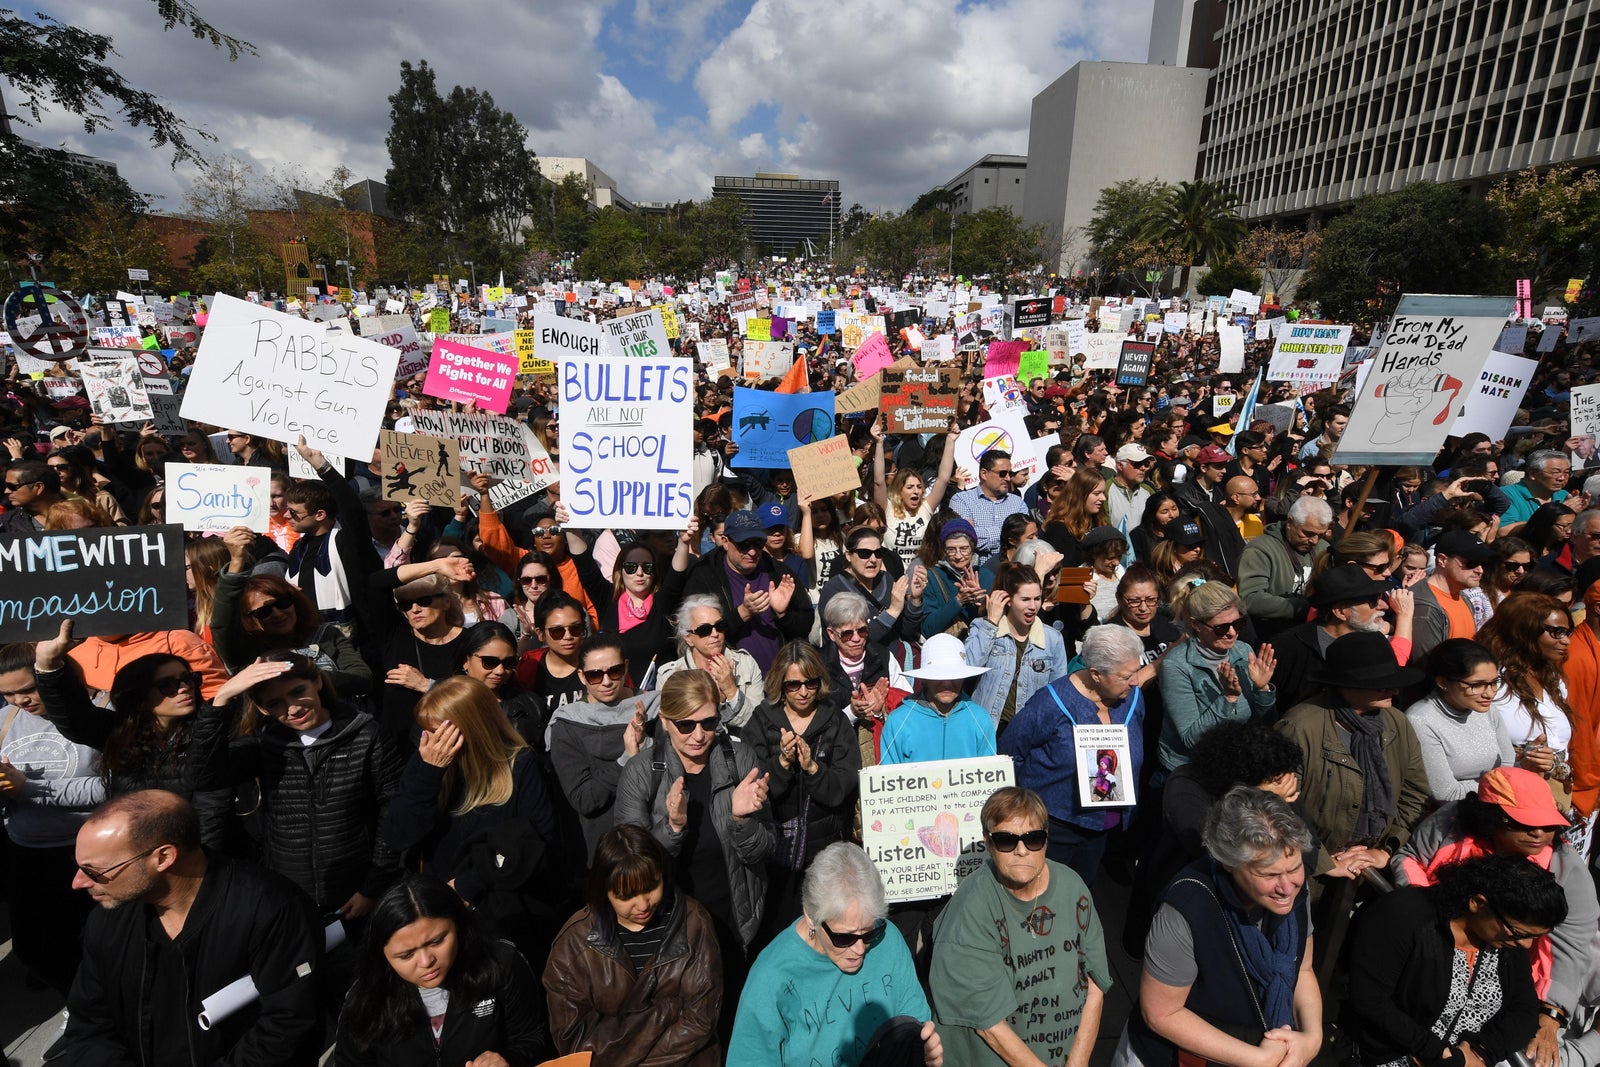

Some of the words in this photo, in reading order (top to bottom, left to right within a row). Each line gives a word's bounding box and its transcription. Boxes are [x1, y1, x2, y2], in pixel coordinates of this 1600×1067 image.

[607, 322, 624, 336] THE
[624, 313, 654, 333] SAFETY
[1291, 327, 1314, 337] HOW
[1314, 329, 1341, 338] MANY
[1436, 318, 1464, 340] My
[541, 328, 599, 356] ENOUGH
[619, 335, 631, 347] OF
[633, 331, 649, 342] OUR
[1386, 333, 1419, 346] Cold
[251, 319, 379, 388] RABBIS
[623, 339, 658, 357] LIVES
[1279, 343, 1306, 353] MORE
[1306, 344, 1330, 353] NEED
[1330, 345, 1343, 354] TO
[439, 348, 496, 372] Together
[497, 362, 513, 376] We
[522, 360, 550, 368] GUNS!
[1125, 353, 1148, 362] NEVER
[1381, 352, 1442, 373] Hands
[438, 364, 473, 381] Fight
[475, 372, 492, 386] for
[492, 378, 507, 390] All
[883, 368, 904, 383] how
[940, 372, 950, 383] is
[1122, 364, 1146, 373] AGAIN
[565, 361, 689, 403] BULLETS
[1481, 371, 1522, 388] DISARM
[222, 360, 308, 402] Against
[315, 390, 357, 420] Gun
[881, 385, 900, 393] our
[1480, 385, 1509, 399] HATE
[1217, 398, 1231, 406] LESS
[1573, 393, 1596, 406] THE
[250, 398, 340, 443] Violence
[587, 407, 613, 422] ARE
[619, 407, 648, 422] NOT
[894, 406, 956, 421] gender-inclusive
[413, 415, 444, 433] HOW
[449, 416, 487, 435] MANY
[489, 419, 522, 441] TEARS
[388, 432, 414, 446] I'LL
[492, 437, 526, 456] BLOOD
[386, 444, 437, 464] NEVER
[568, 431, 680, 474] SCHOOL
[468, 460, 484, 474] IT
[487, 458, 526, 478] TAKE?
[419, 475, 447, 500] GROW
[529, 479, 548, 494] CLASS
[177, 472, 252, 520] Sanity
[438, 488, 456, 506] UP
[570, 477, 692, 518] SUPPLIES
[26, 535, 78, 573] ME
[78, 533, 166, 567] WITH
[869, 775, 928, 794] Listen
[948, 768, 1006, 787] Listen
[896, 794, 937, 804] CHILDREN
[943, 791, 958, 799] with
[871, 808, 886, 816] PAY
[889, 804, 937, 815] ATTENTION
[866, 846, 926, 864] Listen
[890, 866, 912, 874] YOUR
[915, 863, 941, 872] HEART
[957, 858, 983, 867] ANGER
[886, 877, 895, 885] A
[899, 871, 941, 884] FRIEND
[915, 885, 943, 894] SOMETH
[1048, 1047, 1063, 1060] TO
